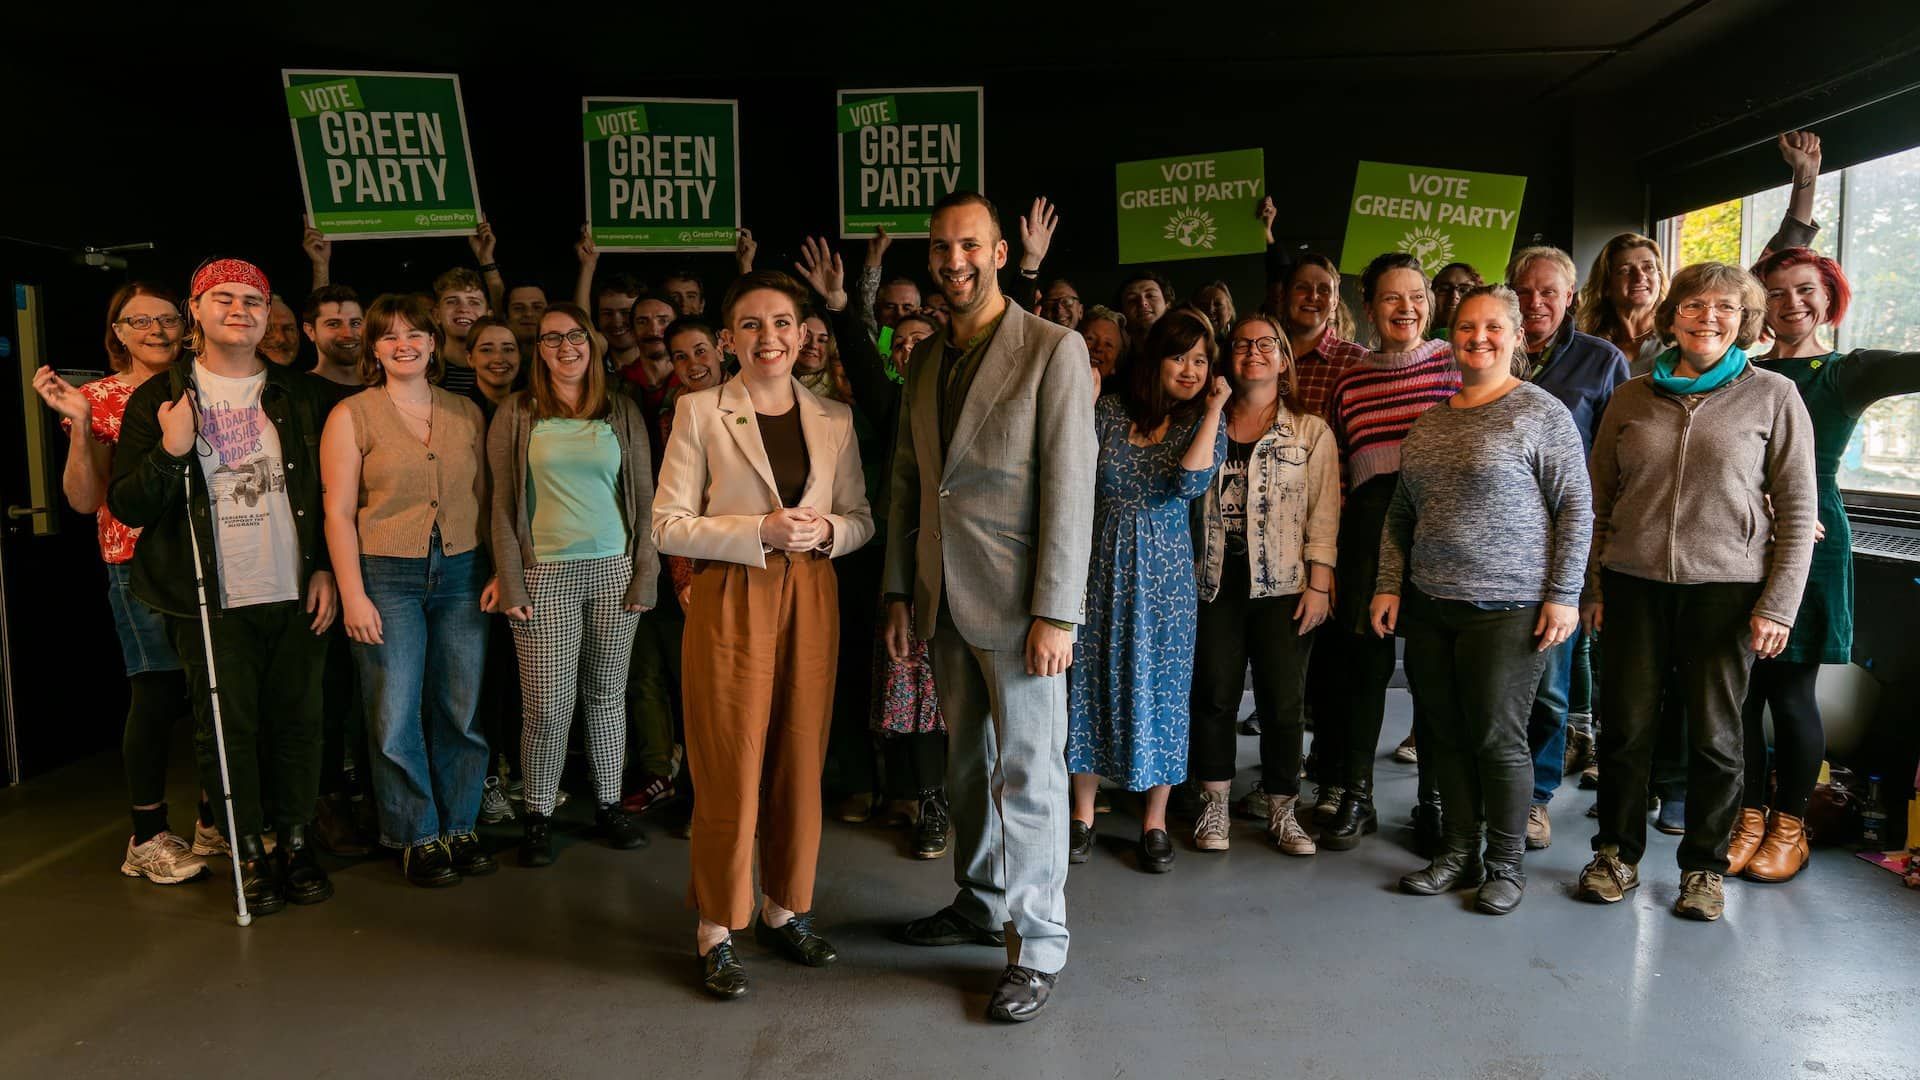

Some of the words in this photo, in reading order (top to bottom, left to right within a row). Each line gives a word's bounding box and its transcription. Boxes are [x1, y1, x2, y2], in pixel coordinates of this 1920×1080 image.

[300, 84, 354, 112] VOTE
[596, 110, 640, 136] VOTE
[849, 101, 890, 127] VOTE
[318, 111, 446, 156] GREEN
[859, 123, 961, 165] GREEN
[607, 134, 717, 177] GREEN
[326, 158, 447, 203] PARTY
[1161, 160, 1216, 182] VOTE
[609, 178, 717, 219] PARTY
[860, 166, 961, 207] PARTY
[1120, 186, 1188, 209] GREEN
[1194, 178, 1261, 203] PARTY
[1408, 173, 1470, 199] VOTE
[429, 214, 453, 222] Green
[454, 213, 474, 223] Party
[1355, 194, 1432, 221] GREEN
[1437, 202, 1516, 230] PARTY
[692, 231, 713, 239] Green
[714, 231, 734, 240] Party
[215, 421, 261, 449] SMASHES
[219, 438, 263, 465] BORDERS
